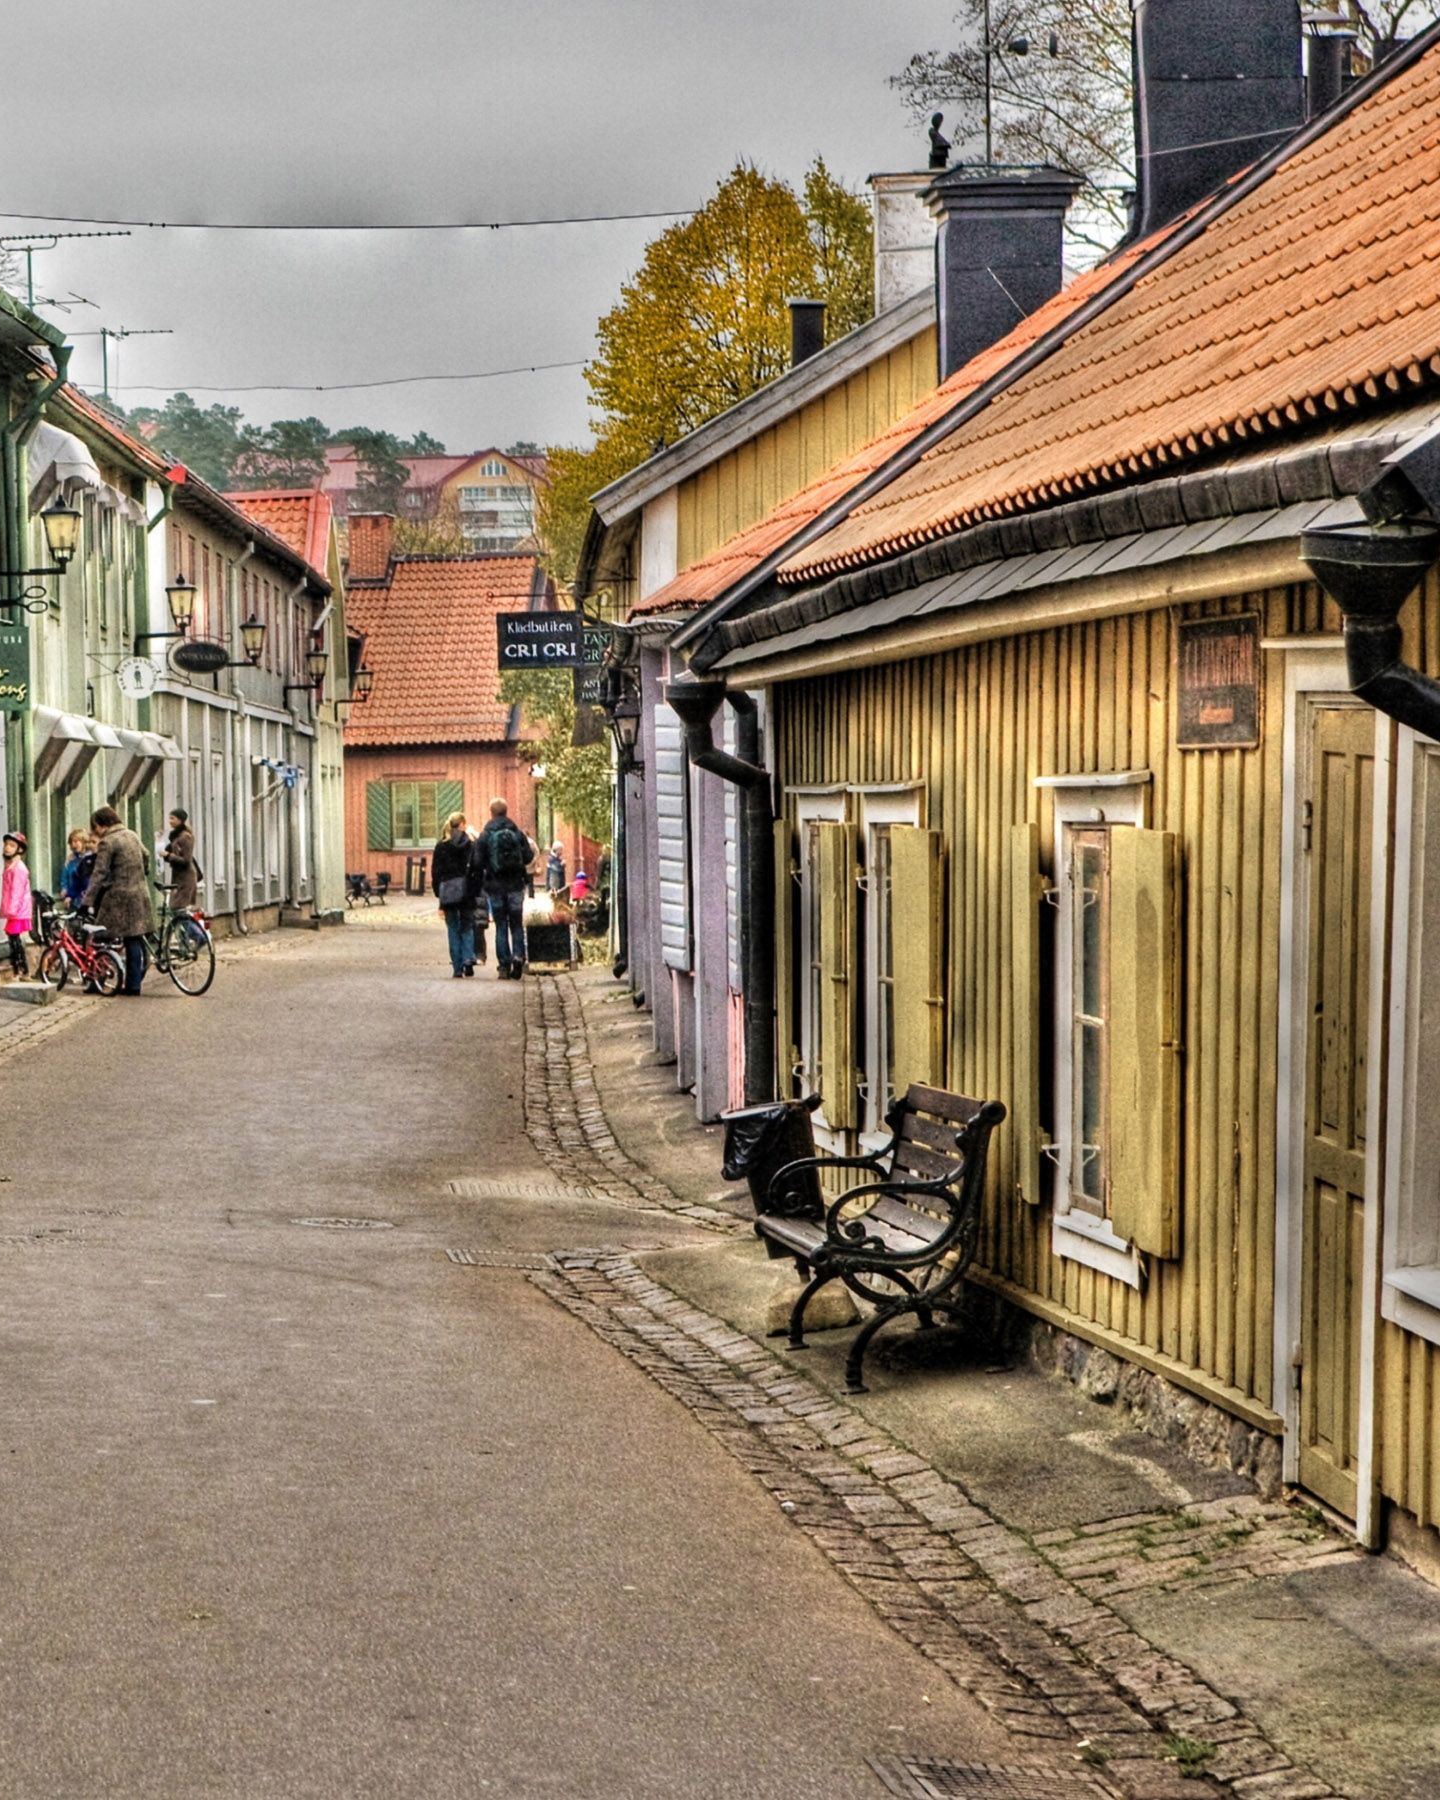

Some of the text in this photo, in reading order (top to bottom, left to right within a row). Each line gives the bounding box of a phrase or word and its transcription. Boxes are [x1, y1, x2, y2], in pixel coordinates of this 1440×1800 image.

[583, 633, 611, 645] TAN
[505, 642, 576, 658] CRI CRI
